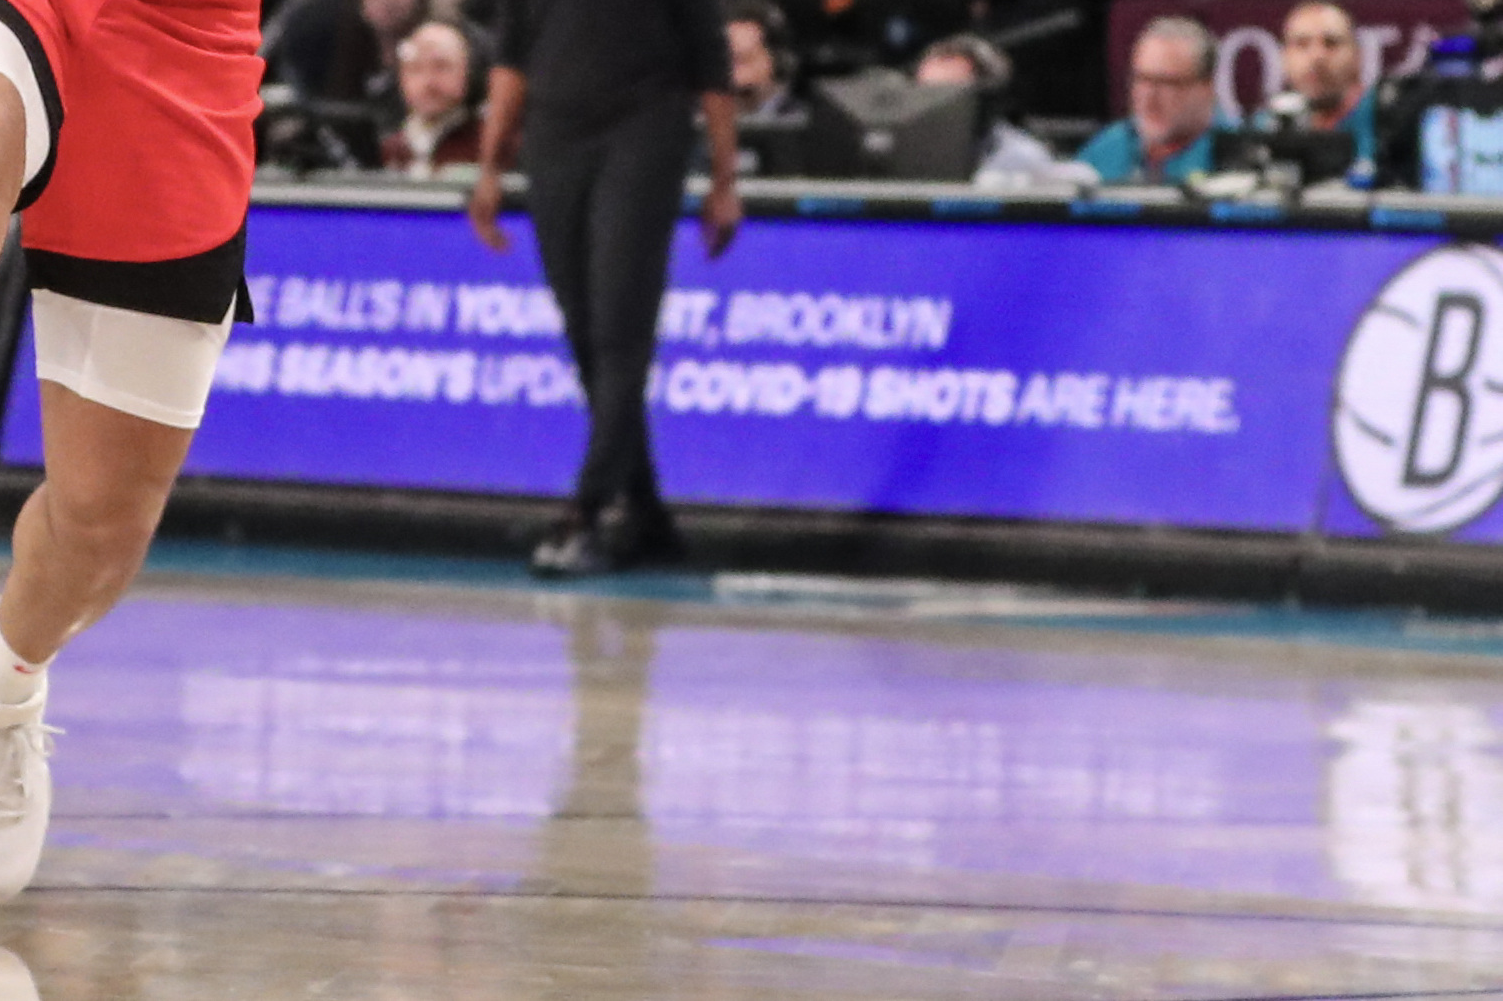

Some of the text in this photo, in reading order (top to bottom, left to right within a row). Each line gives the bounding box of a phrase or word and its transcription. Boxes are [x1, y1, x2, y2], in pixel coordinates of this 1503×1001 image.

[666, 361, 861, 418] COVID-19
[864, 365, 1016, 425] SHOTS
[1017, 371, 1107, 428] ARE
[1402, 291, 1486, 488] B
